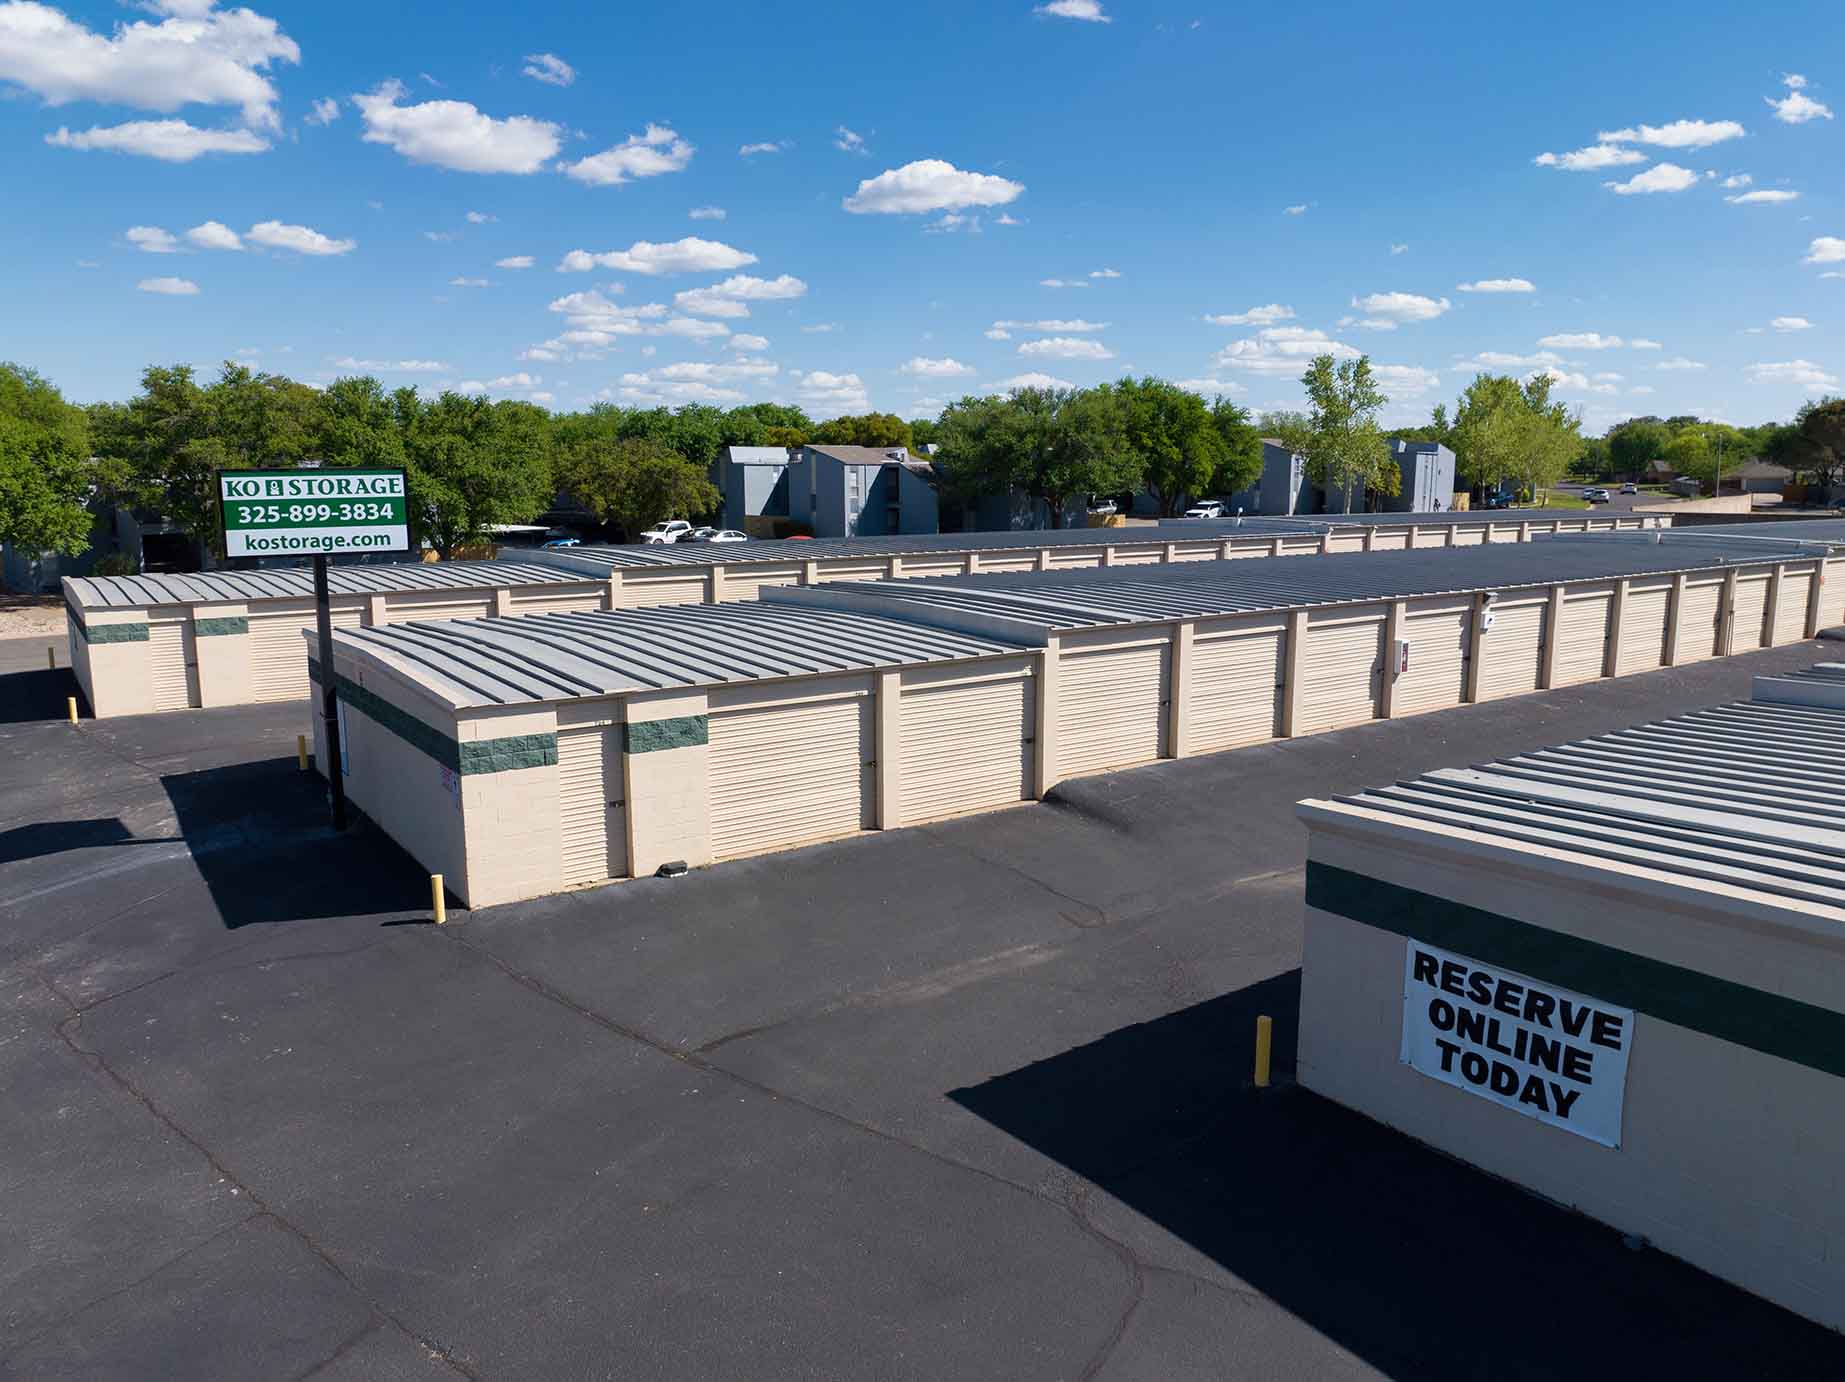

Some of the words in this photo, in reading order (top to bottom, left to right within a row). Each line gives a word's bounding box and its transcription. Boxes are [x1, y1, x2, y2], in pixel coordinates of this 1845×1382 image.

[225, 480, 260, 497] KO
[289, 477, 401, 496] STORAGE
[238, 503, 394, 524] 325-899-3834
[245, 534, 391, 551] kostorage.com
[1413, 950, 1624, 1051] RESERVE
[1428, 998, 1594, 1085] ONLINE
[1435, 1037, 1581, 1119] TODAY
